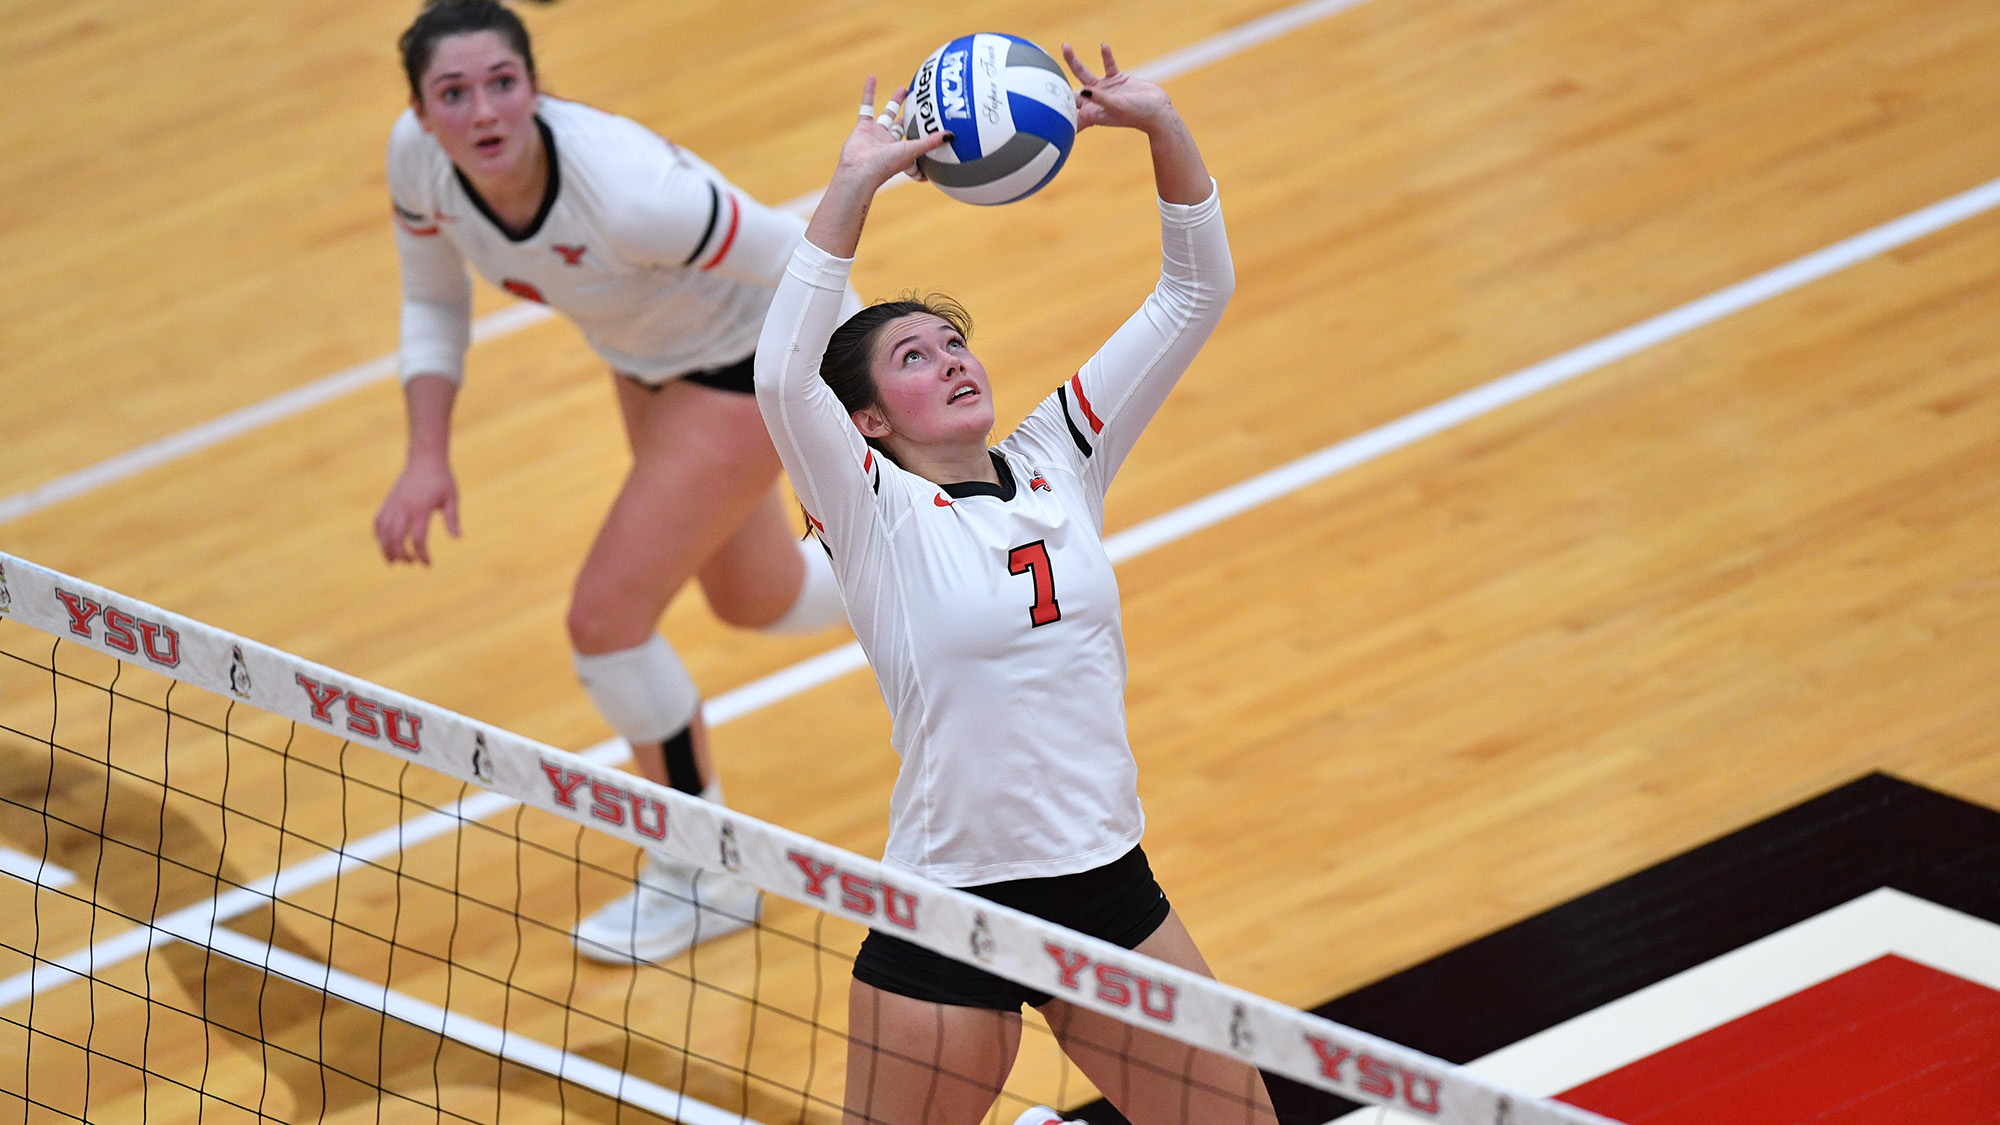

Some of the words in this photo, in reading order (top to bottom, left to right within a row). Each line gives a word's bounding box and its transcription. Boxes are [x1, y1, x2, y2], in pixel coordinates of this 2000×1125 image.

[941, 50, 970, 120] NCAA
[982, 81, 1004, 125] Super
[1008, 539, 1061, 628] 7
[56, 587, 181, 668] YSU
[295, 674, 422, 753] YSU
[540, 759, 667, 842] YSU
[787, 851, 919, 930] YSU
[1044, 941, 1178, 1023] YSU
[1306, 1034, 1441, 1115] YSU
